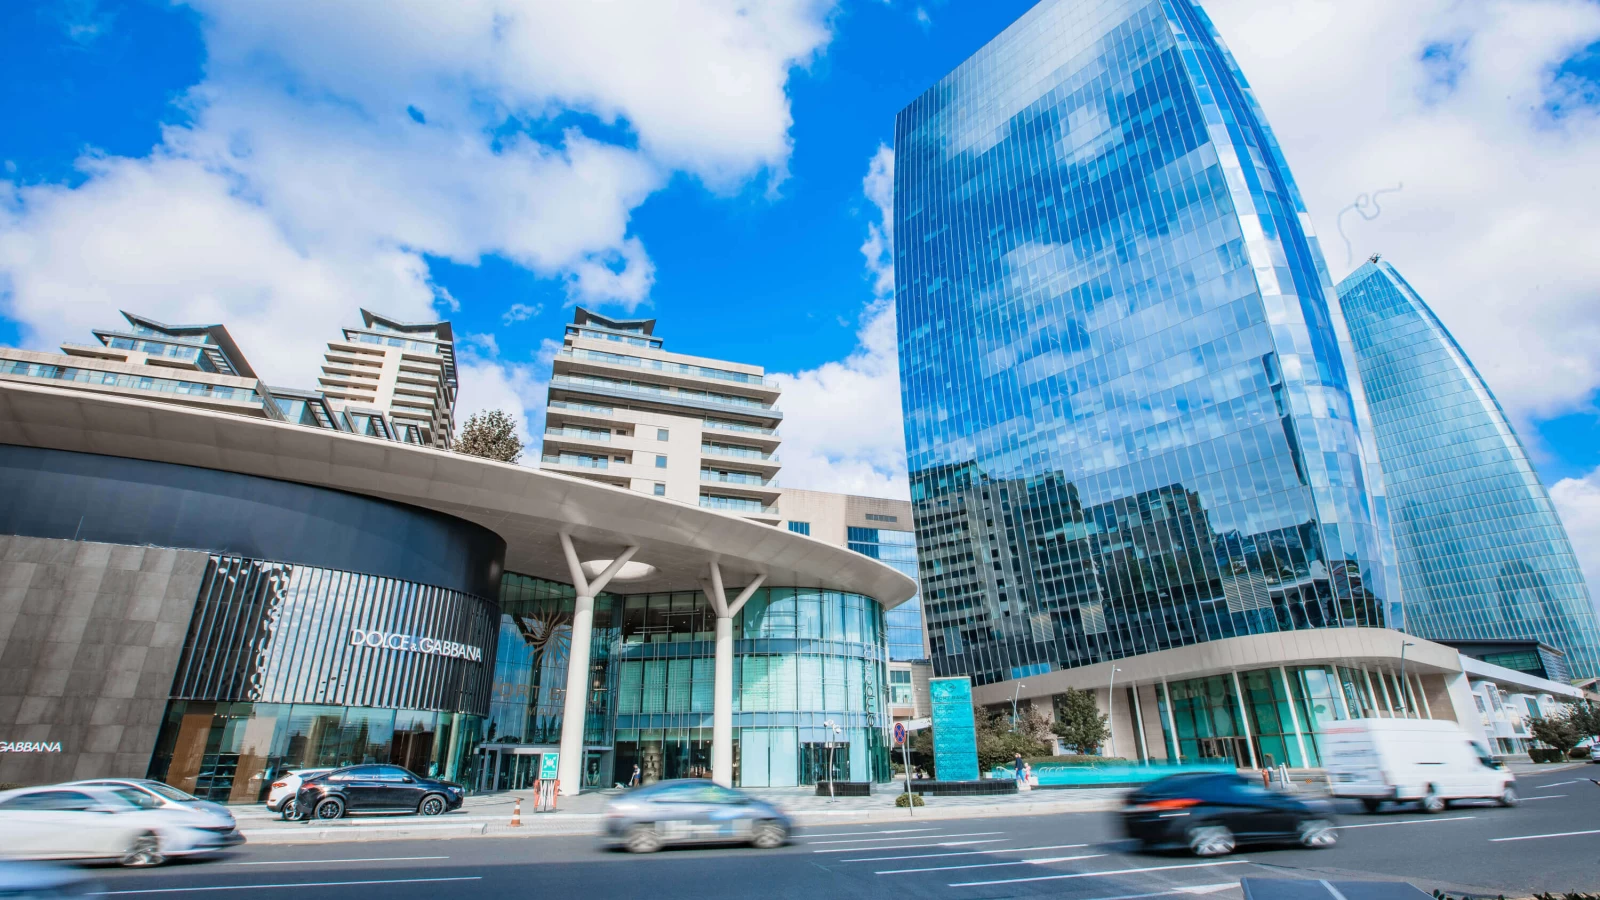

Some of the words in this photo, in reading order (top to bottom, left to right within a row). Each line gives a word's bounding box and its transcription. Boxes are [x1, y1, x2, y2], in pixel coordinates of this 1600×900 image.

[351, 629, 410, 650] DOLCE
[410, 643, 417, 652] &
[420, 637, 481, 662] GABBANA
[0, 741, 62, 752] GABBANA
